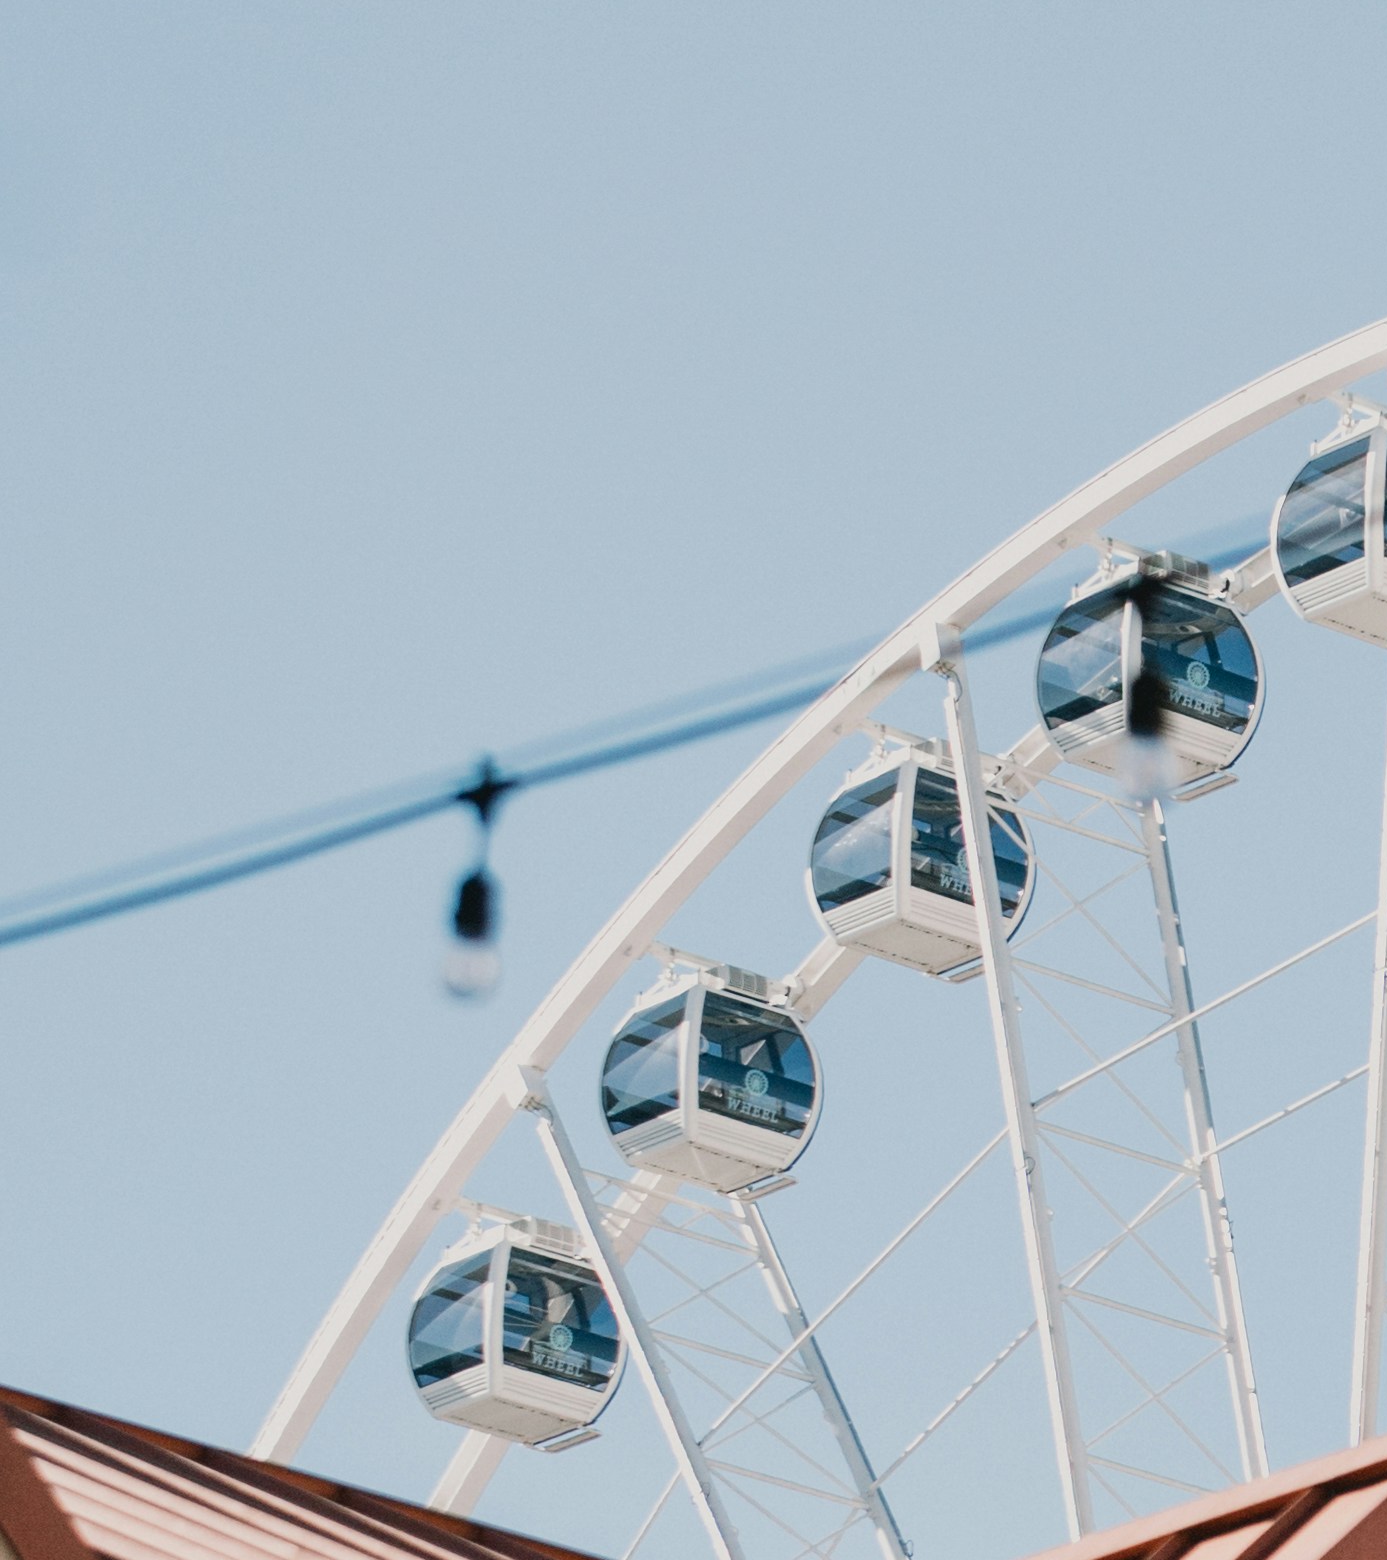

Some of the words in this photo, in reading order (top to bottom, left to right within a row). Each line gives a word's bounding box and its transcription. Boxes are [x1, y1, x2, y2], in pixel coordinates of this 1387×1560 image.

[940, 873, 973, 896] WHE
[727, 1096, 779, 1124] WHEEL
[532, 1351, 584, 1377] WHEEL
